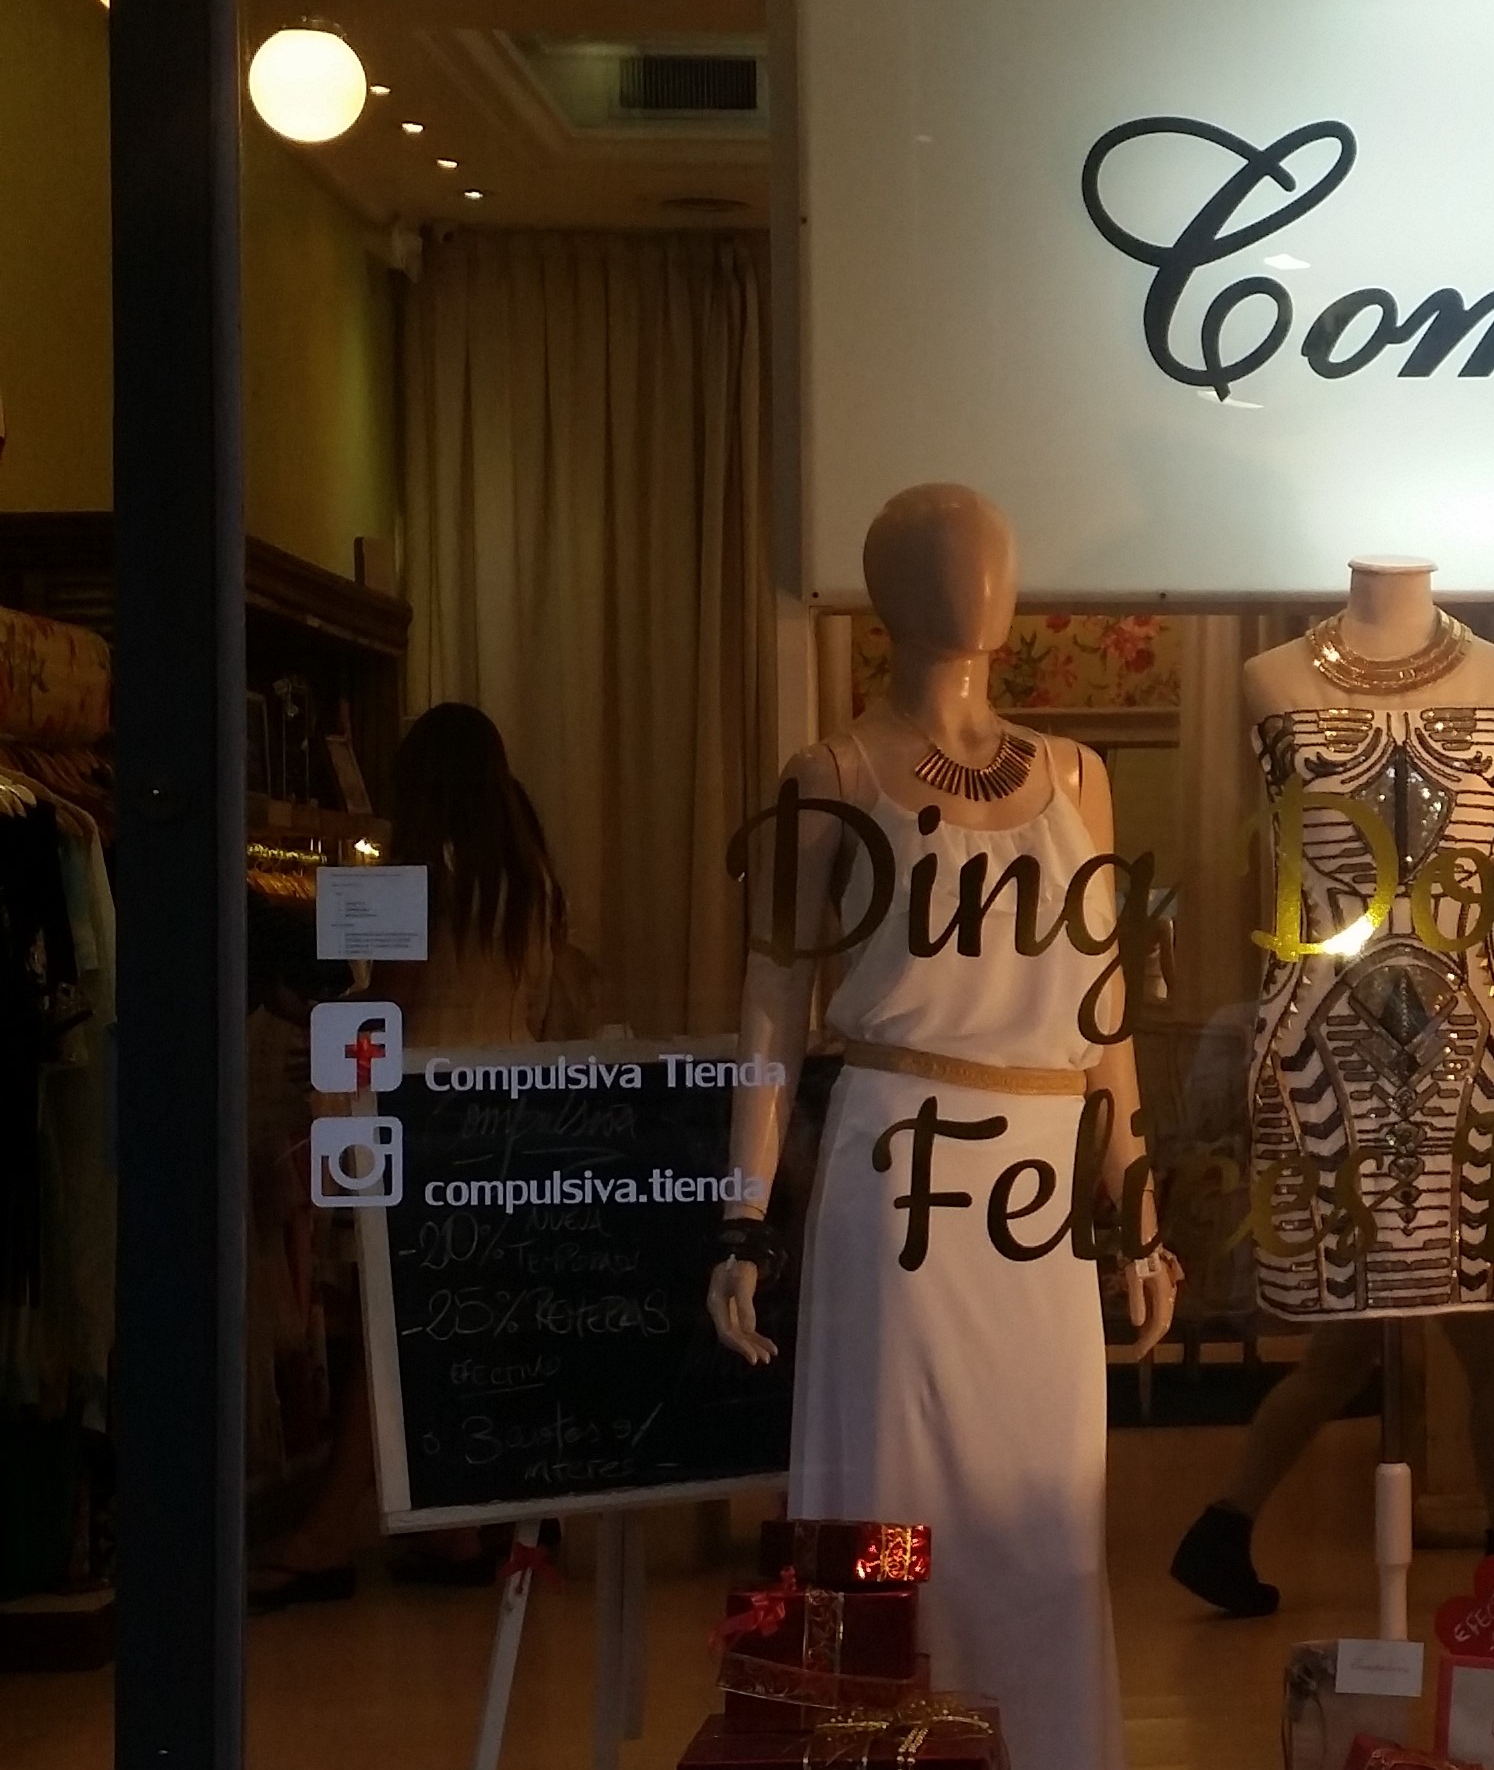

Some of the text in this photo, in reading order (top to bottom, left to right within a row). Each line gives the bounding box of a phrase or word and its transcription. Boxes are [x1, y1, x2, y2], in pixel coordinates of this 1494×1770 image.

[725, 776, 1180, 1045] Ding
[424, 1053, 786, 1099] Compulsiva Tienda
[424, 1167, 767, 1213] compulsiva.tienda
[401, 1286, 528, 1342] -25%
